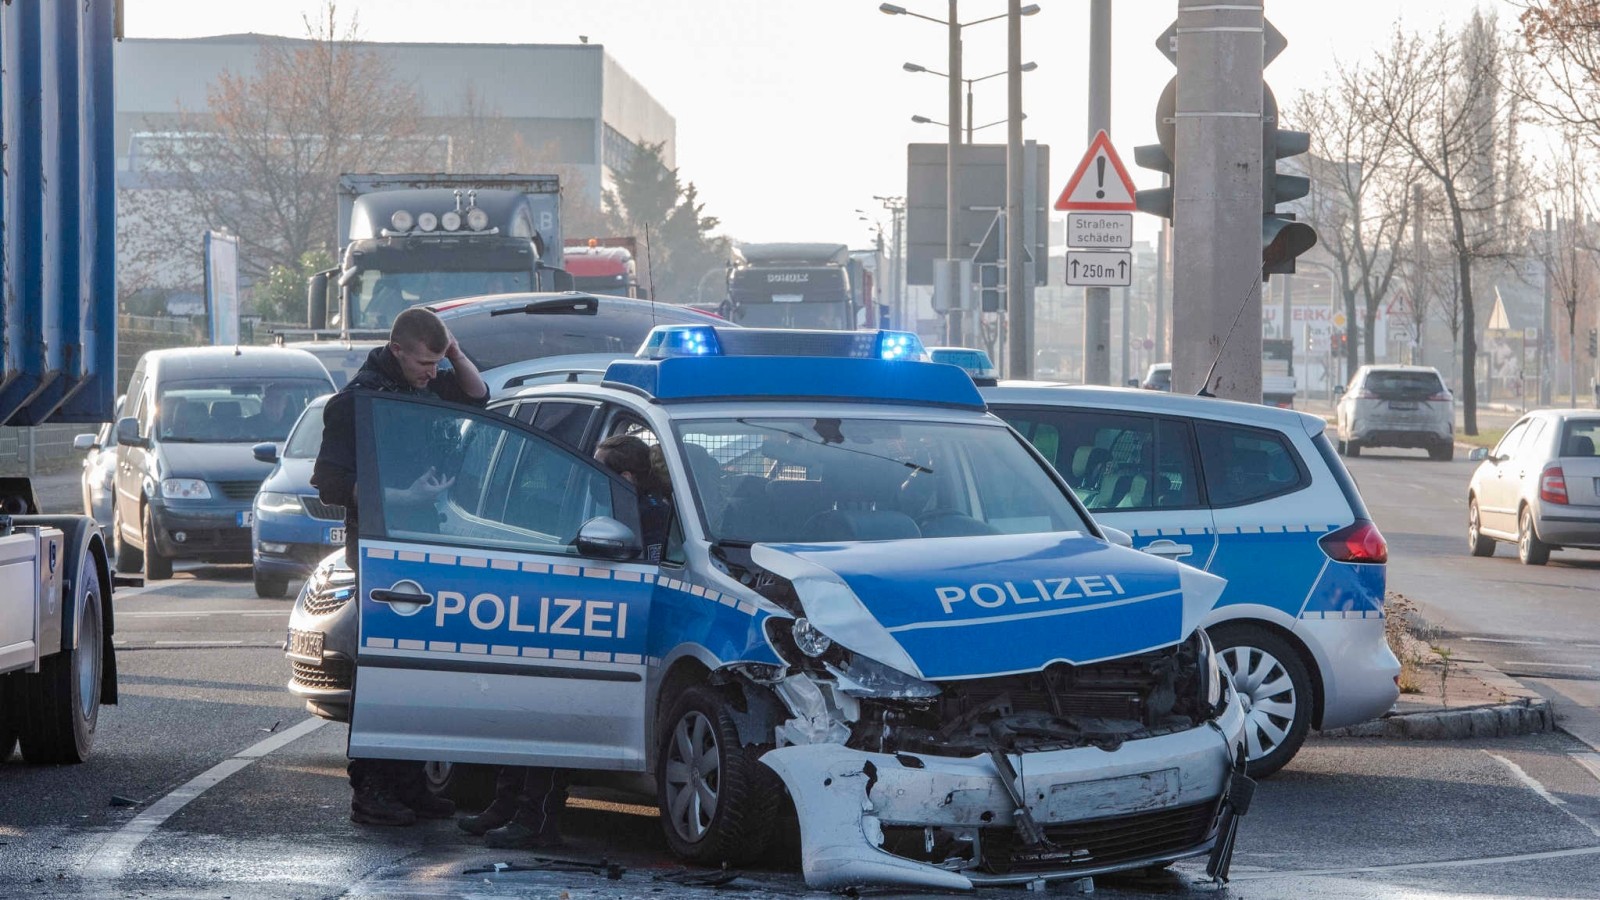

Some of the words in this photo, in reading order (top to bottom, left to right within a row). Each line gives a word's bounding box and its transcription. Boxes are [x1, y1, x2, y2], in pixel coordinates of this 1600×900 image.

[540, 211, 553, 230] B
[1076, 219, 1124, 229] Straßen-
[1077, 232, 1122, 242] schäden
[1265, 309, 1276, 320] U
[935, 574, 1125, 614] POLIZEI
[435, 590, 627, 639] POLIZEI
